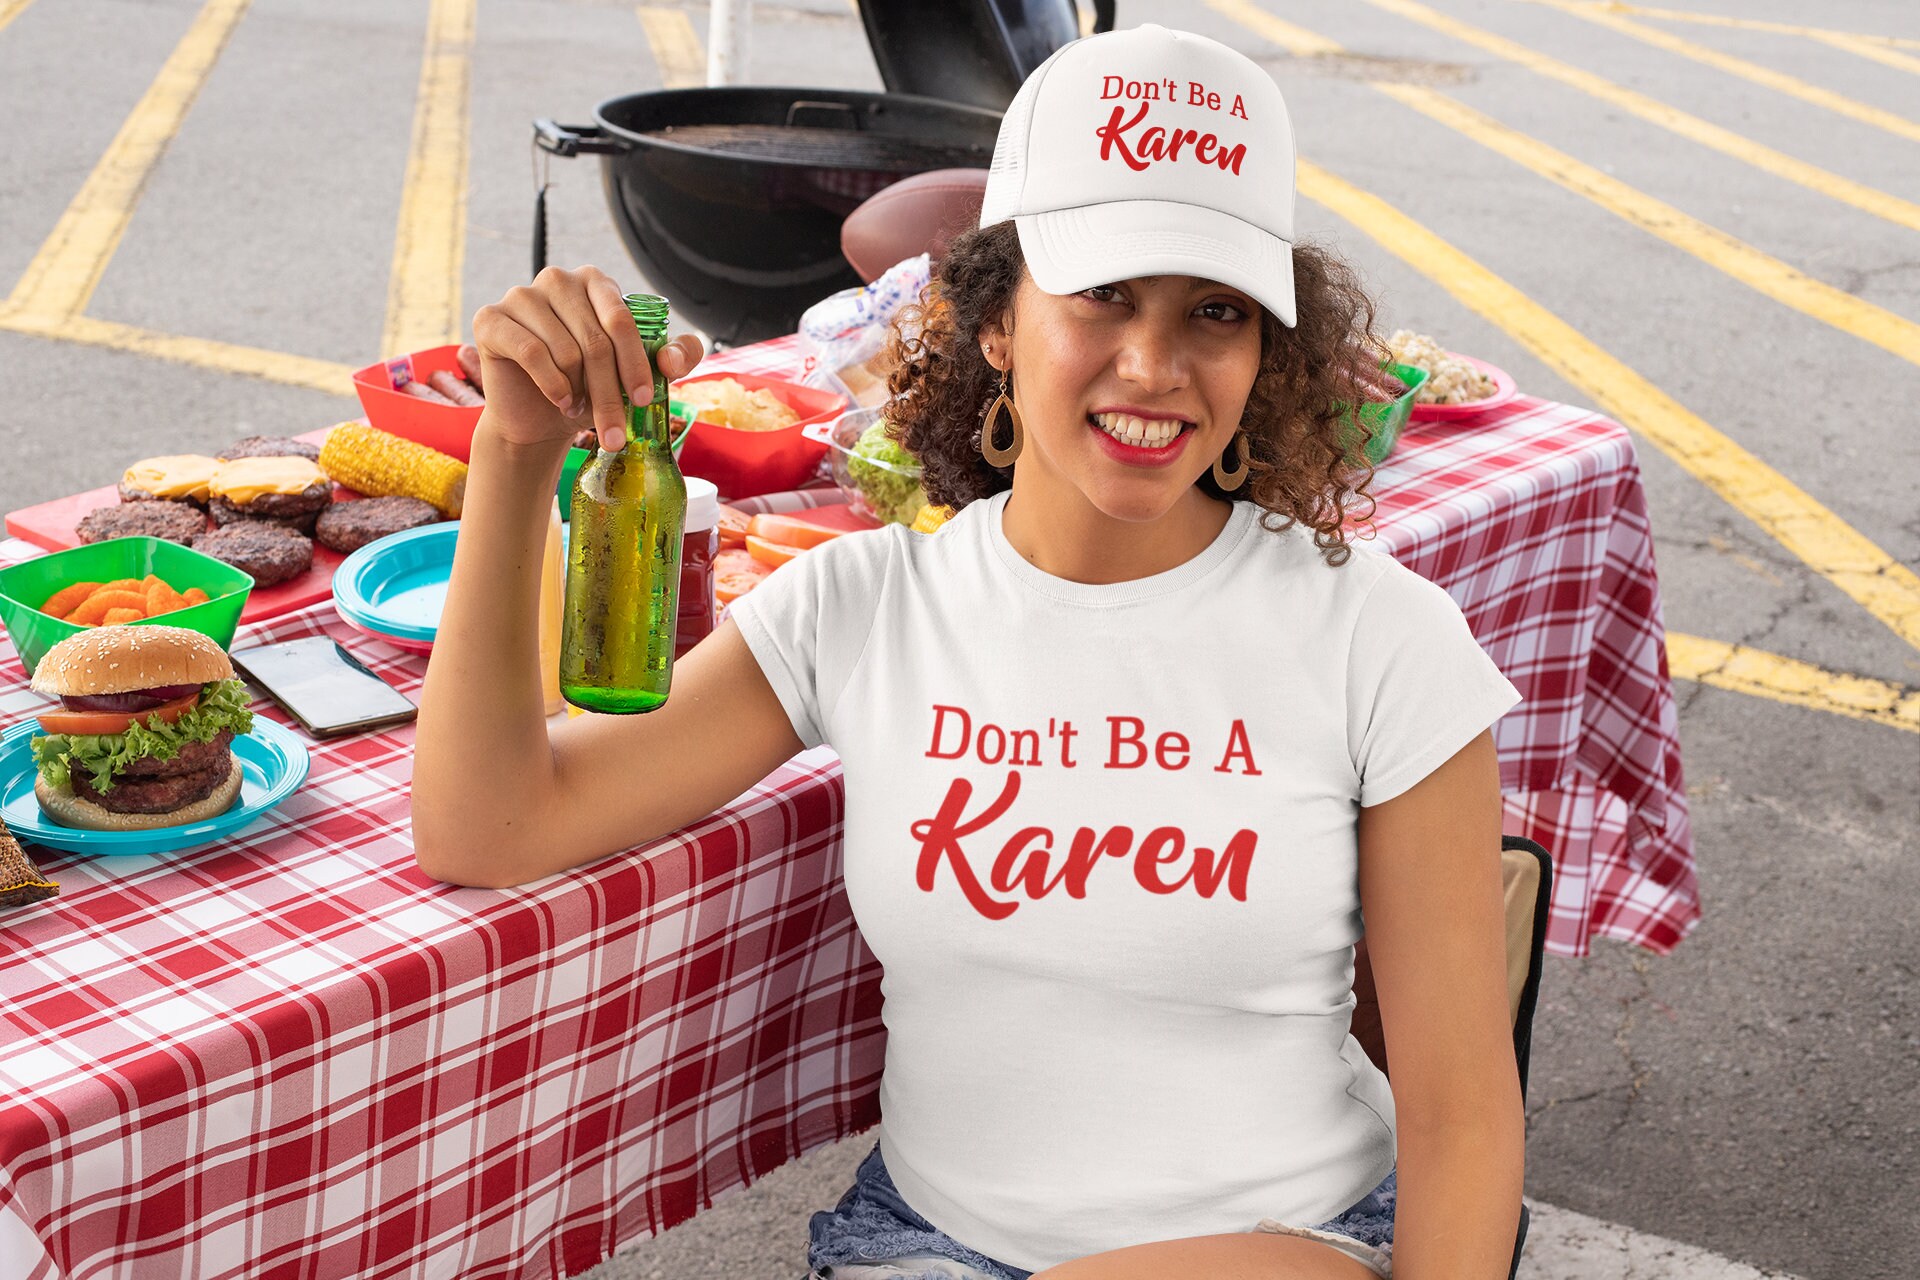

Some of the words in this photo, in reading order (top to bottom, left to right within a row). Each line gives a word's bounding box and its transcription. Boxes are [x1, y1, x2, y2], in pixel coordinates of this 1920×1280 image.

[1100, 75, 1178, 102] Don't
[1187, 82, 1222, 111] Be
[1230, 94, 1248, 120] A
[1095, 100, 1247, 176] Karen
[924, 704, 1079, 768] Don't
[1103, 715, 1191, 771] Be
[1213, 719, 1263, 776] A
[909, 769, 1259, 921] Karen
